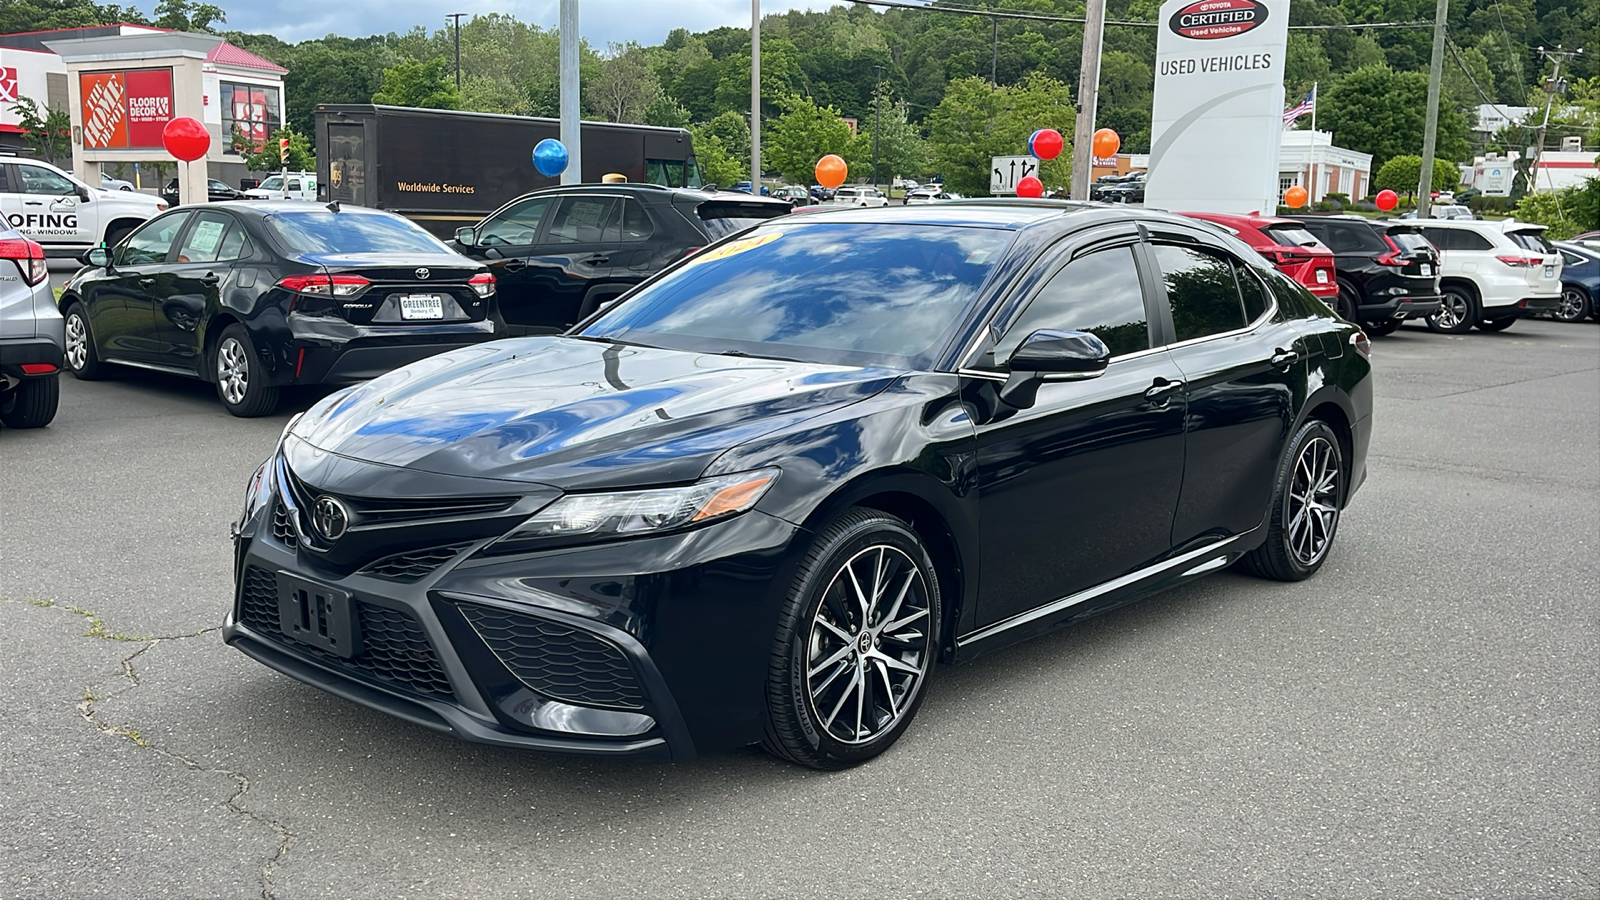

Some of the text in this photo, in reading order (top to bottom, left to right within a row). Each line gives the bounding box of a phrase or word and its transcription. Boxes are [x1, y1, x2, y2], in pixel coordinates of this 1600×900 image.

[1180, 10, 1255, 27] CERTIFIED
[1209, 26, 1242, 34] Vehicles
[1161, 53, 1271, 76] USED VEHICLES
[86, 79, 105, 111] THE
[129, 97, 156, 107] FLOOR
[84, 74, 124, 148] HOME
[130, 107, 156, 116] DECOR
[99, 99, 126, 148] DEPOT
[397, 181, 475, 194] Worldwide Services
[402, 300, 440, 308] GREENTREE
[793, 683, 814, 735] CITYTRAXX
